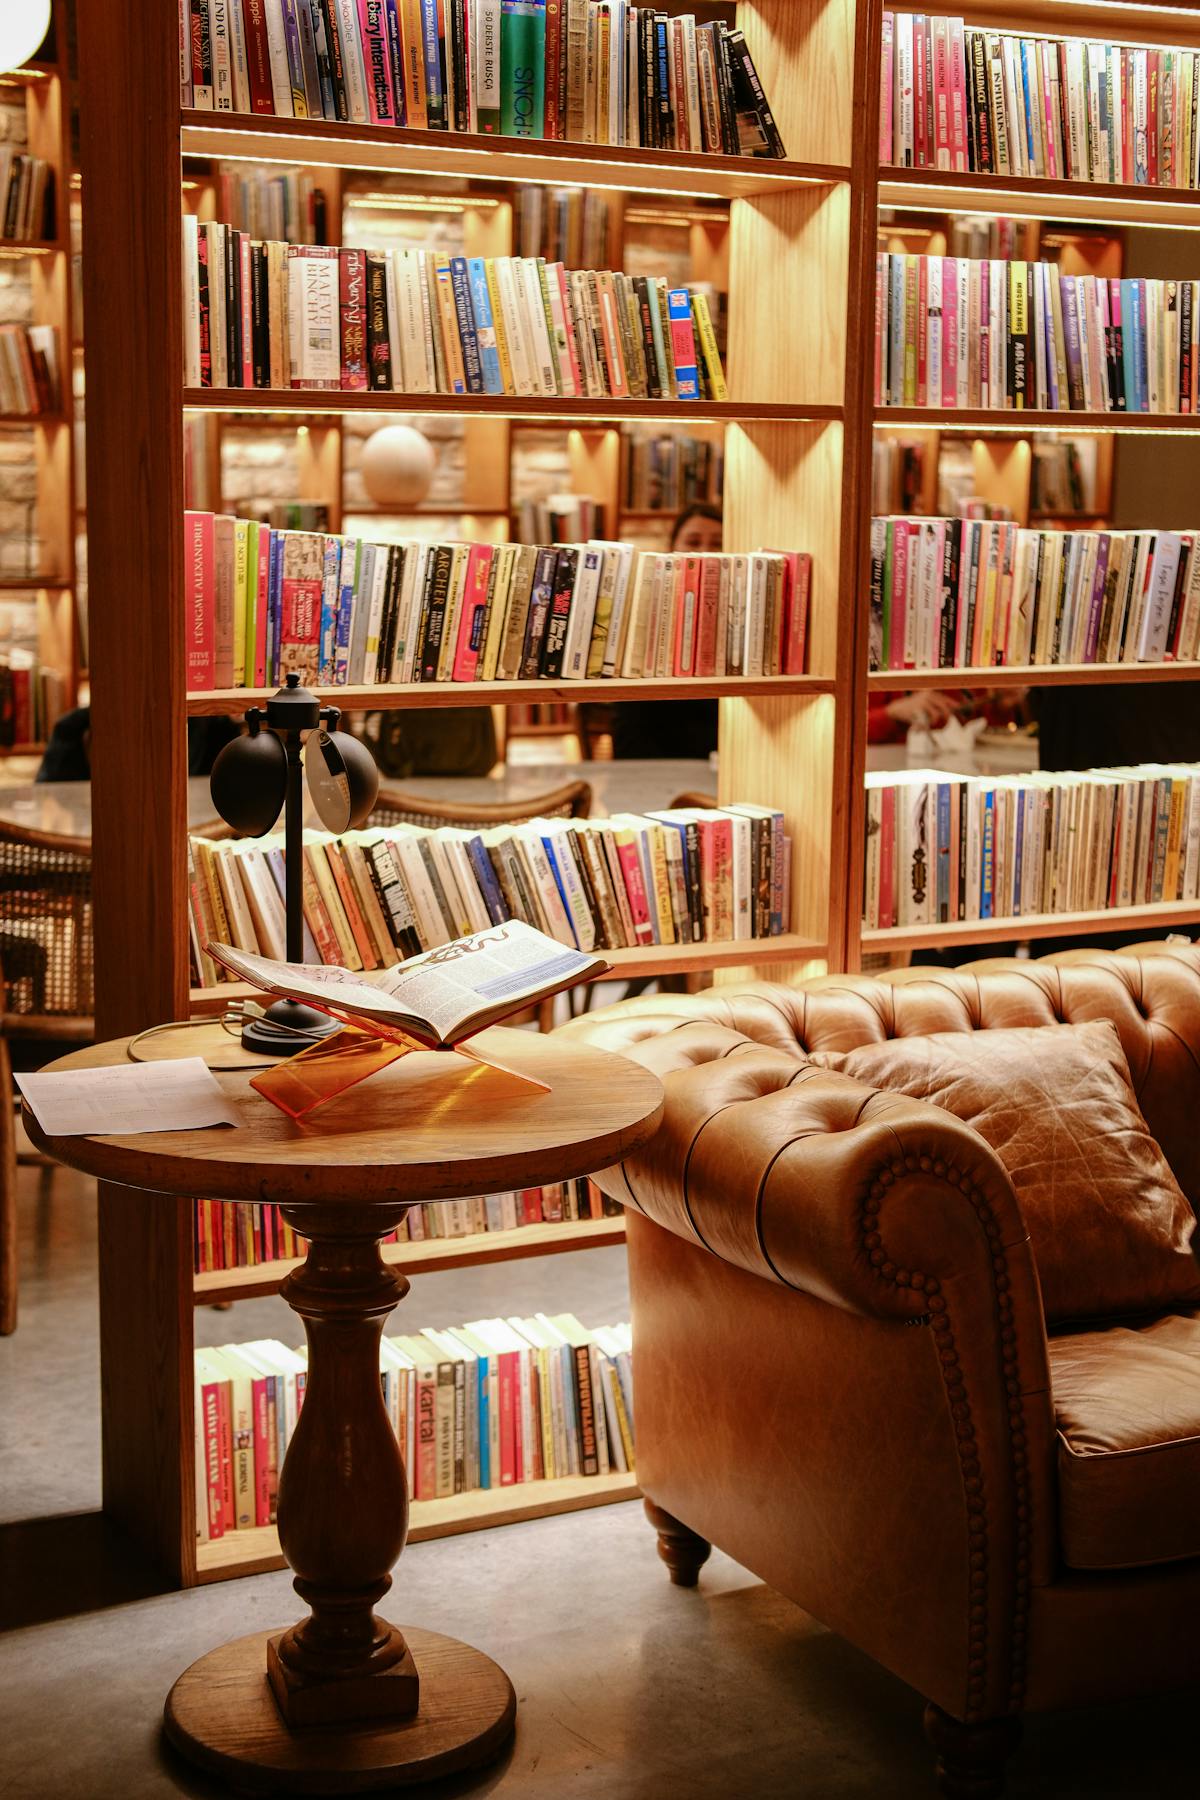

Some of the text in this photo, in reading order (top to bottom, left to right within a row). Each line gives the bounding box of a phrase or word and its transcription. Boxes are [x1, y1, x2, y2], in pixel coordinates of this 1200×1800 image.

[216, 24, 226, 39] OF
[249, 0, 262, 26] pple
[389, 10, 398, 39] Spanish
[646, 19, 654, 34] THE
[364, 1, 393, 120] Diary International
[483, 10, 494, 91] 50 DERSTE RUSÇA
[646, 35, 654, 63] FIELDS
[647, 63, 654, 75] OF
[974, 41, 985, 66] DAVID
[512, 66, 535, 129] PONS
[646, 75, 655, 97] EDEN
[976, 66, 987, 104] BALDACCI
[763, 112, 773, 126] SAS
[306, 263, 320, 327] BINCHY
[318, 264, 332, 326] MAEVE
[343, 251, 364, 324] The Nanny
[453, 273, 467, 334] PAUL THEROUX
[1015, 282, 1024, 316] MUSTAFA
[1066, 293, 1079, 350] NORA ROBERTS
[1183, 284, 1192, 351] SANDRA BROWN
[1014, 341, 1025, 389] ABLUKA
[193, 520, 207, 591] ALEXANDRIE
[236, 546, 245, 574] LE LION
[432, 550, 451, 606] ARCHER
[894, 548, 906, 598] Çikolata
[296, 589, 306, 640] DICTIONARY
[304, 592, 315, 637] PASSWORD
[553, 592, 565, 615] SMITH
[560, 589, 572, 615] WILBUR
[555, 619, 568, 639] When
[774, 815, 785, 886] MEGATRENDS
[558, 847, 593, 940] HARLAN COBEN PROMISE ME
[419, 1385, 436, 1444] kartal
[576, 1348, 597, 1457] NOSTRADAMUS
[206, 1393, 222, 1484] SAFİYE SULTAN
[239, 1451, 250, 1495] GERMINAL
